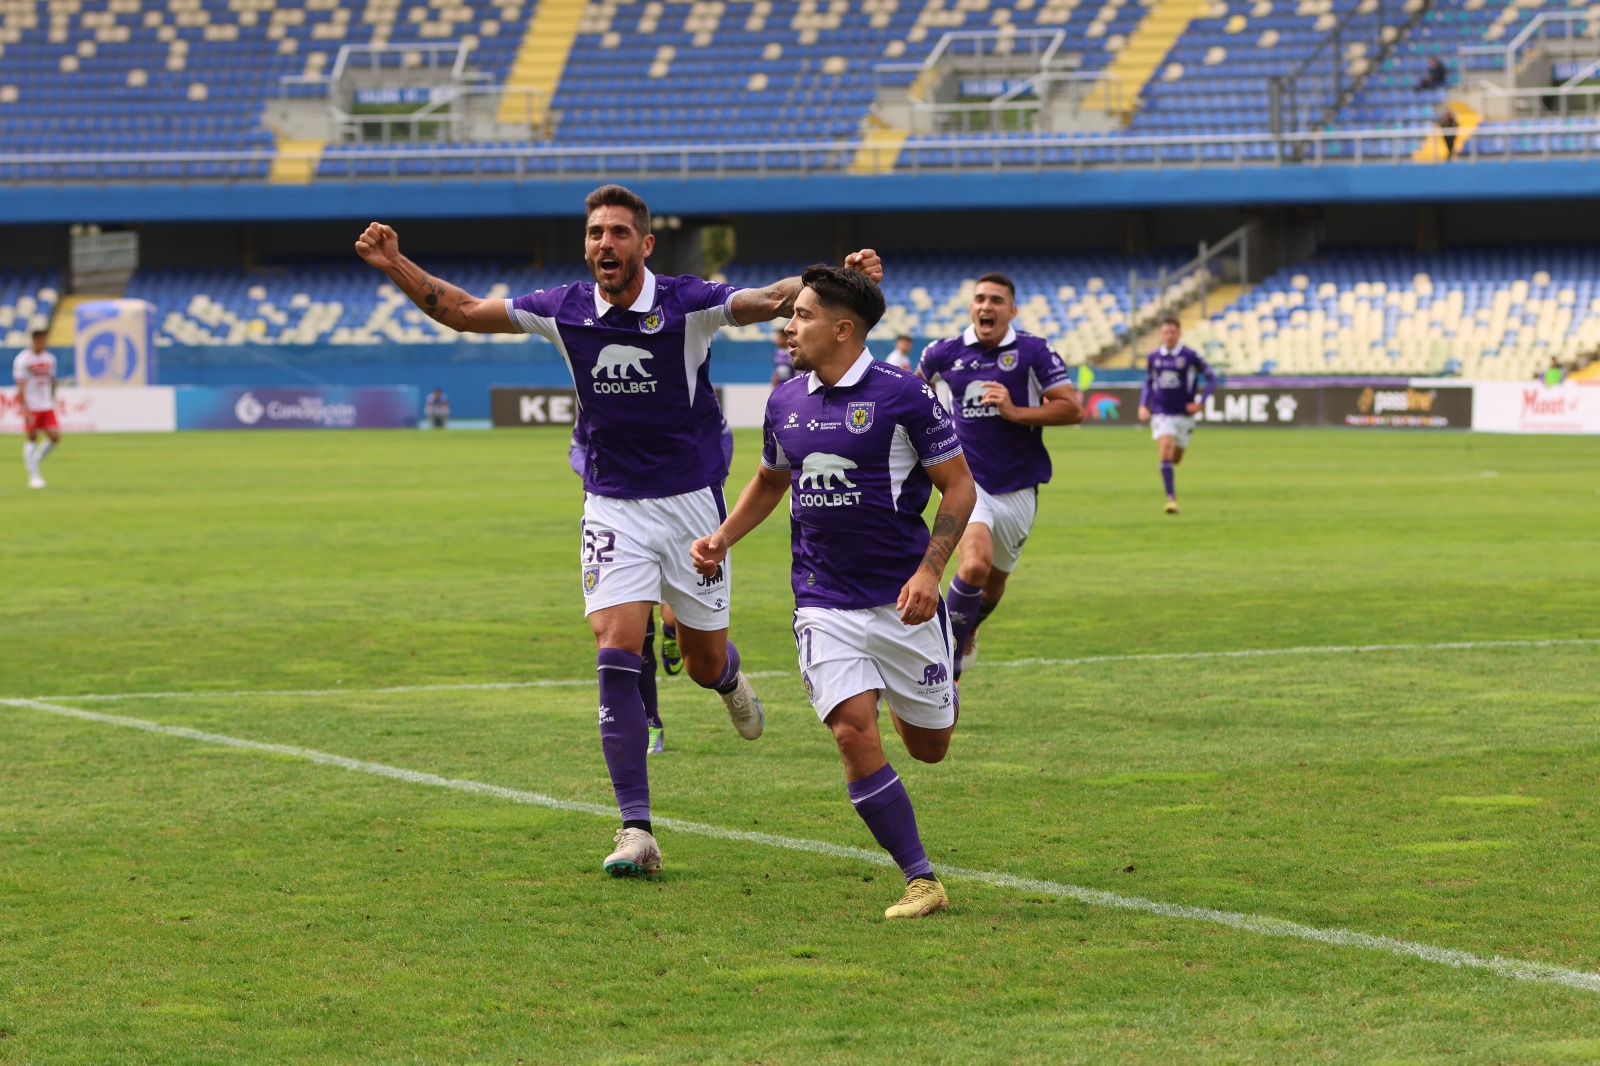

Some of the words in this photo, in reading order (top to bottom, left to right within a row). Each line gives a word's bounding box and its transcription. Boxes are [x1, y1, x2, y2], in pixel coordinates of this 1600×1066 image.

[593, 381, 658, 394] COOLBET
[519, 394, 575, 423] KE
[799, 491, 862, 507] COOLBET
